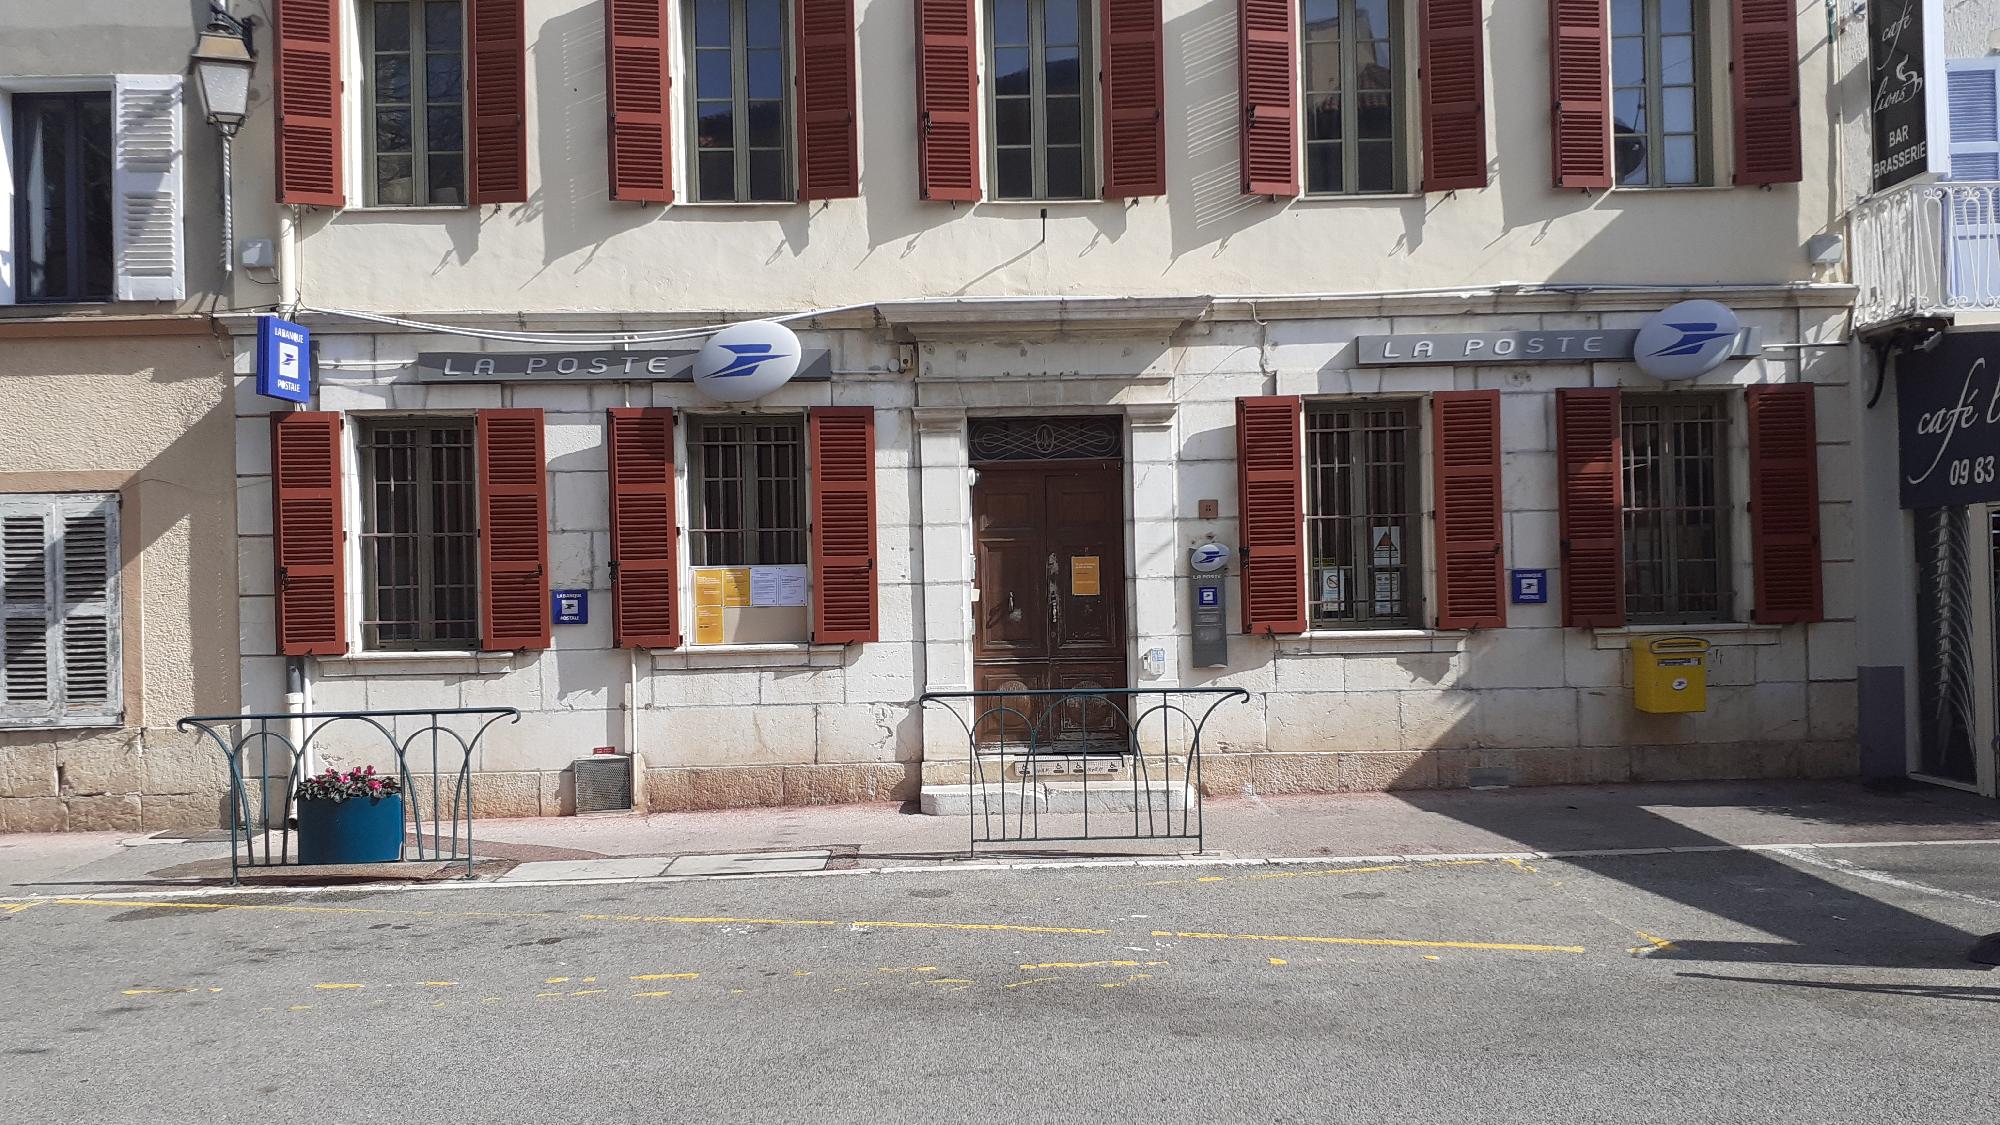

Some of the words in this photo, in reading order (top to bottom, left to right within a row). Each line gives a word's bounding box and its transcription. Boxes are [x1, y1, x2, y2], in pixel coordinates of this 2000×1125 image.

[1876, 0, 1913, 70] café
[1889, 125, 1909, 148] BAR
[1873, 141, 1926, 179] BRASSERIE
[1382, 340, 1434, 358] LA
[1463, 336, 1604, 357] POSTE
[443, 358, 496, 375] LA
[525, 356, 669, 374] POSTE
[277, 379, 301, 393] POSTALE
[1907, 357, 1985, 485] café
[1950, 459, 1970, 485] 09
[1974, 455, 1995, 484] 83
